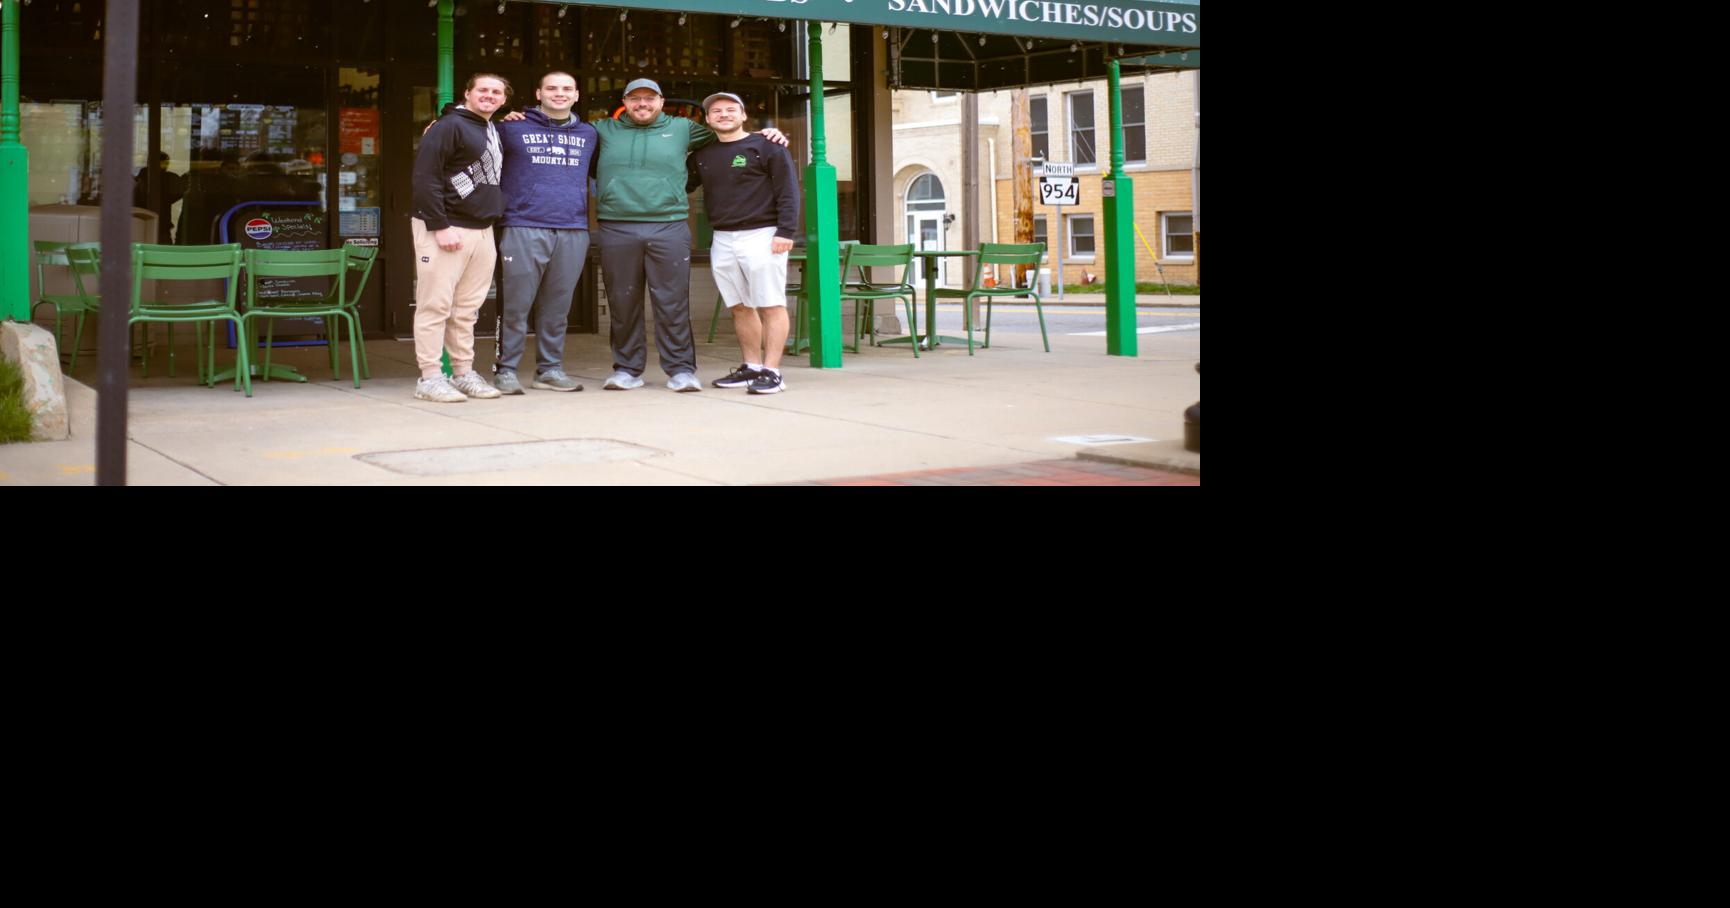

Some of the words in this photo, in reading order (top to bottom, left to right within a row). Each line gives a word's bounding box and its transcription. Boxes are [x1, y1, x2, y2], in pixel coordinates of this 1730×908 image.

[888, 0, 1197, 33] SANDWICHES/SOUPS
[522, 133, 554, 144] GREAT
[558, 134, 586, 148] SMOKY
[531, 155, 580, 166] MOUNTAINS
[1045, 165, 1072, 174] NORTH
[1043, 183, 1075, 199] 954
